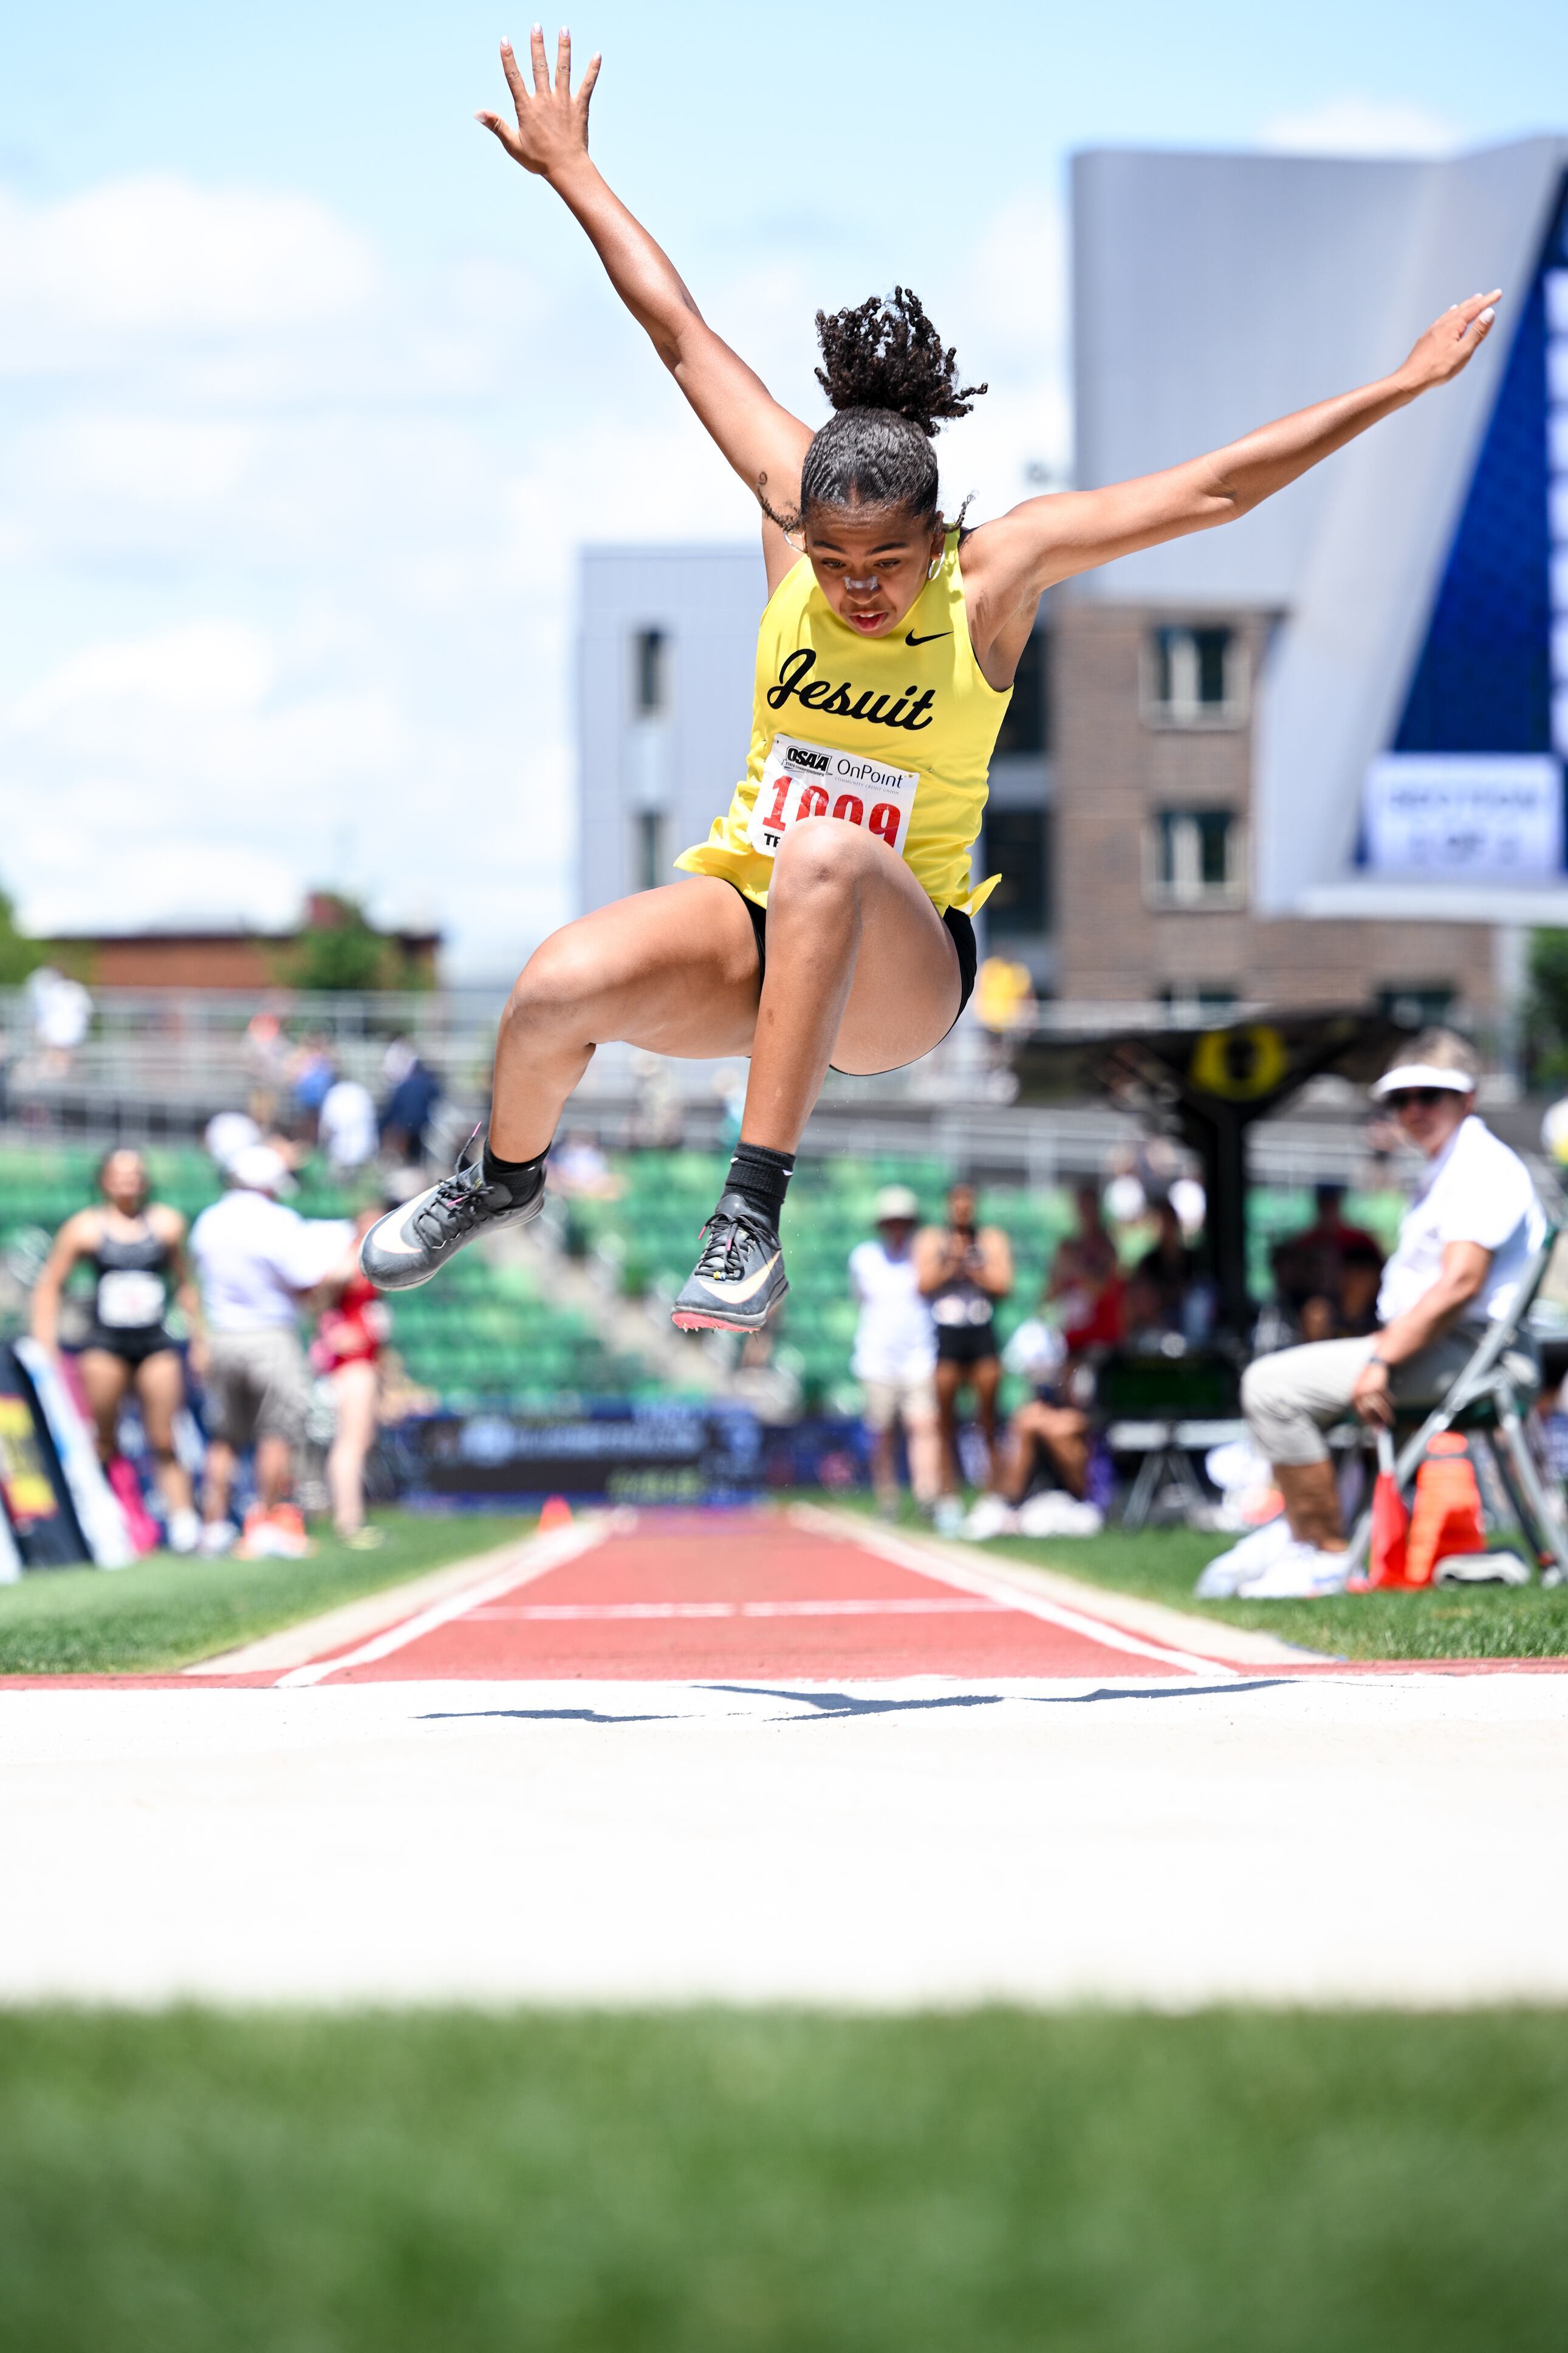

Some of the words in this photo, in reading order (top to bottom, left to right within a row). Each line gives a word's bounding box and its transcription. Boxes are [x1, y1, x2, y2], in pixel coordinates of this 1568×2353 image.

[767, 648, 936, 731] Jesuit
[787, 747, 830, 772] OSAA
[795, 764, 825, 777] CHAMPIONSHIPS
[835, 777, 864, 788] COMMUNITY
[837, 759, 903, 789] OnPoint
